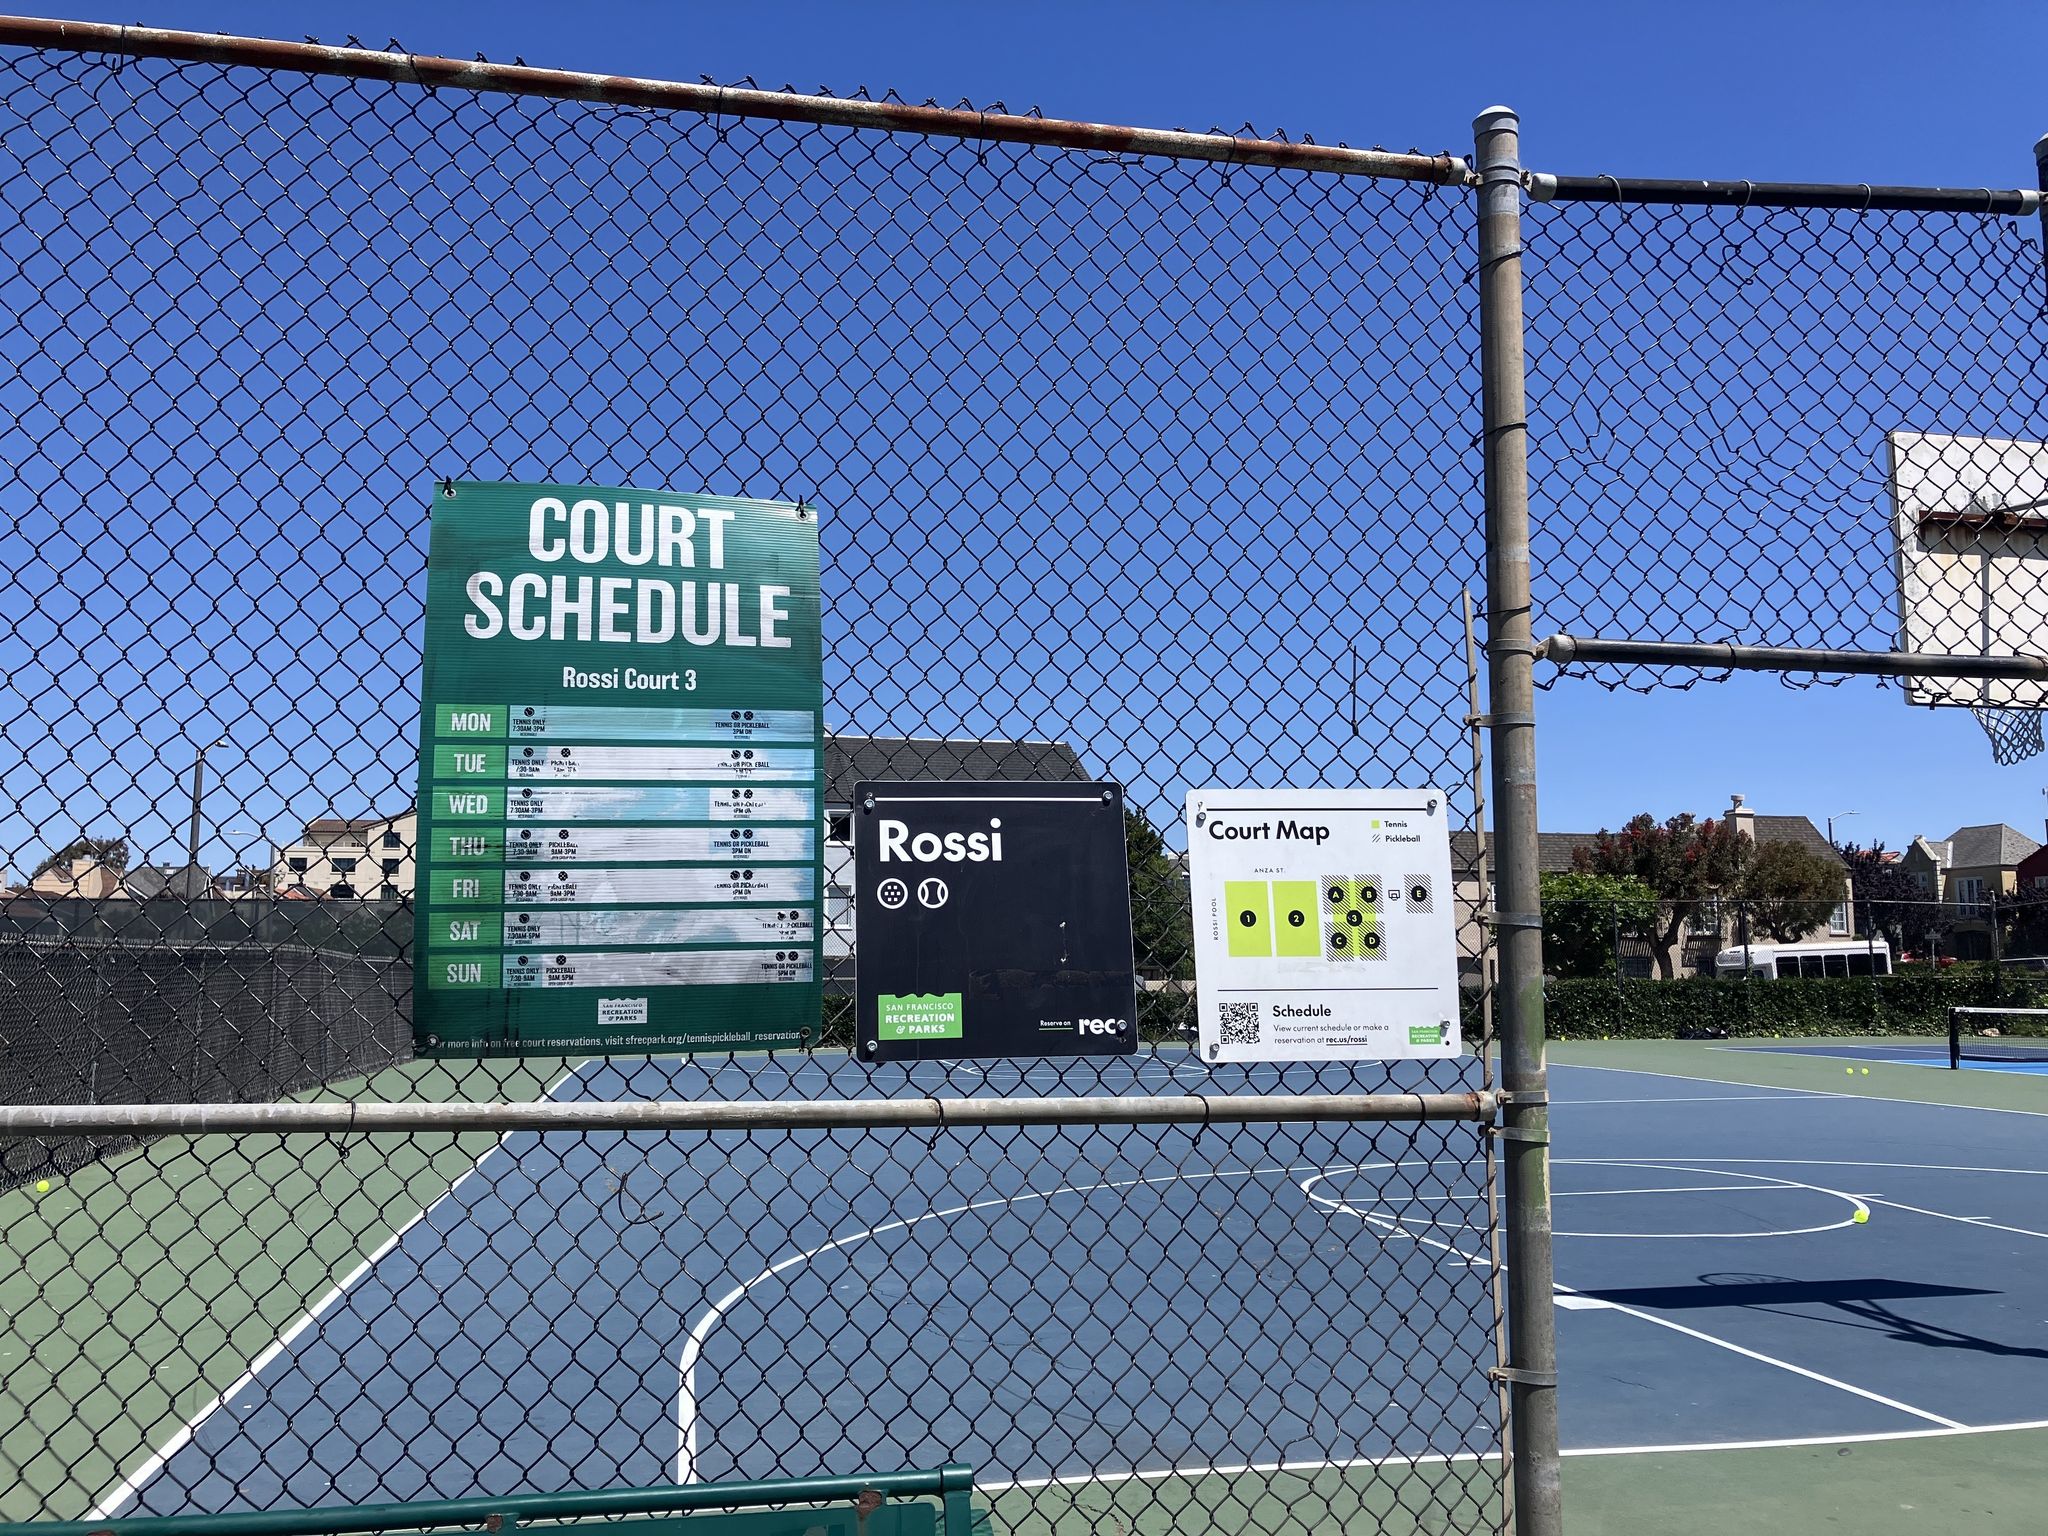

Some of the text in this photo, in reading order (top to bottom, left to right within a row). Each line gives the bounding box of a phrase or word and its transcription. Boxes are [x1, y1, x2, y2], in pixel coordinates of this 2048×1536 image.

[529, 497, 735, 570] COURT
[464, 571, 791, 648] SCHEDULE
[563, 667, 696, 691] Rossi Court 3
[451, 713, 491, 731] MON
[454, 754, 485, 772] TUE
[449, 794, 488, 814] WED
[879, 818, 1002, 862] Rossi
[1209, 820, 1329, 845] Court Map
[1385, 834, 1420, 843] Pickleball
[450, 837, 484, 855] THU
[453, 879, 479, 897] FRI
[1333, 890, 1339, 898] A
[1366, 890, 1372, 898] B
[450, 922, 481, 941] SAT
[1369, 936, 1375, 944] D
[447, 964, 481, 982] SUN
[886, 1003, 902, 1011] SAN
[1273, 1005, 1331, 1017] Schedule
[886, 1013, 954, 1023] RECREATION
[896, 1024, 945, 1034] & PARKS
[472, 1039, 488, 1047] info
[523, 1039, 545, 1047] court
[547, 1037, 603, 1047] reservations,
[605, 1036, 623, 1046] visit
[1326, 1035, 1367, 1044] rec.us/rossi
